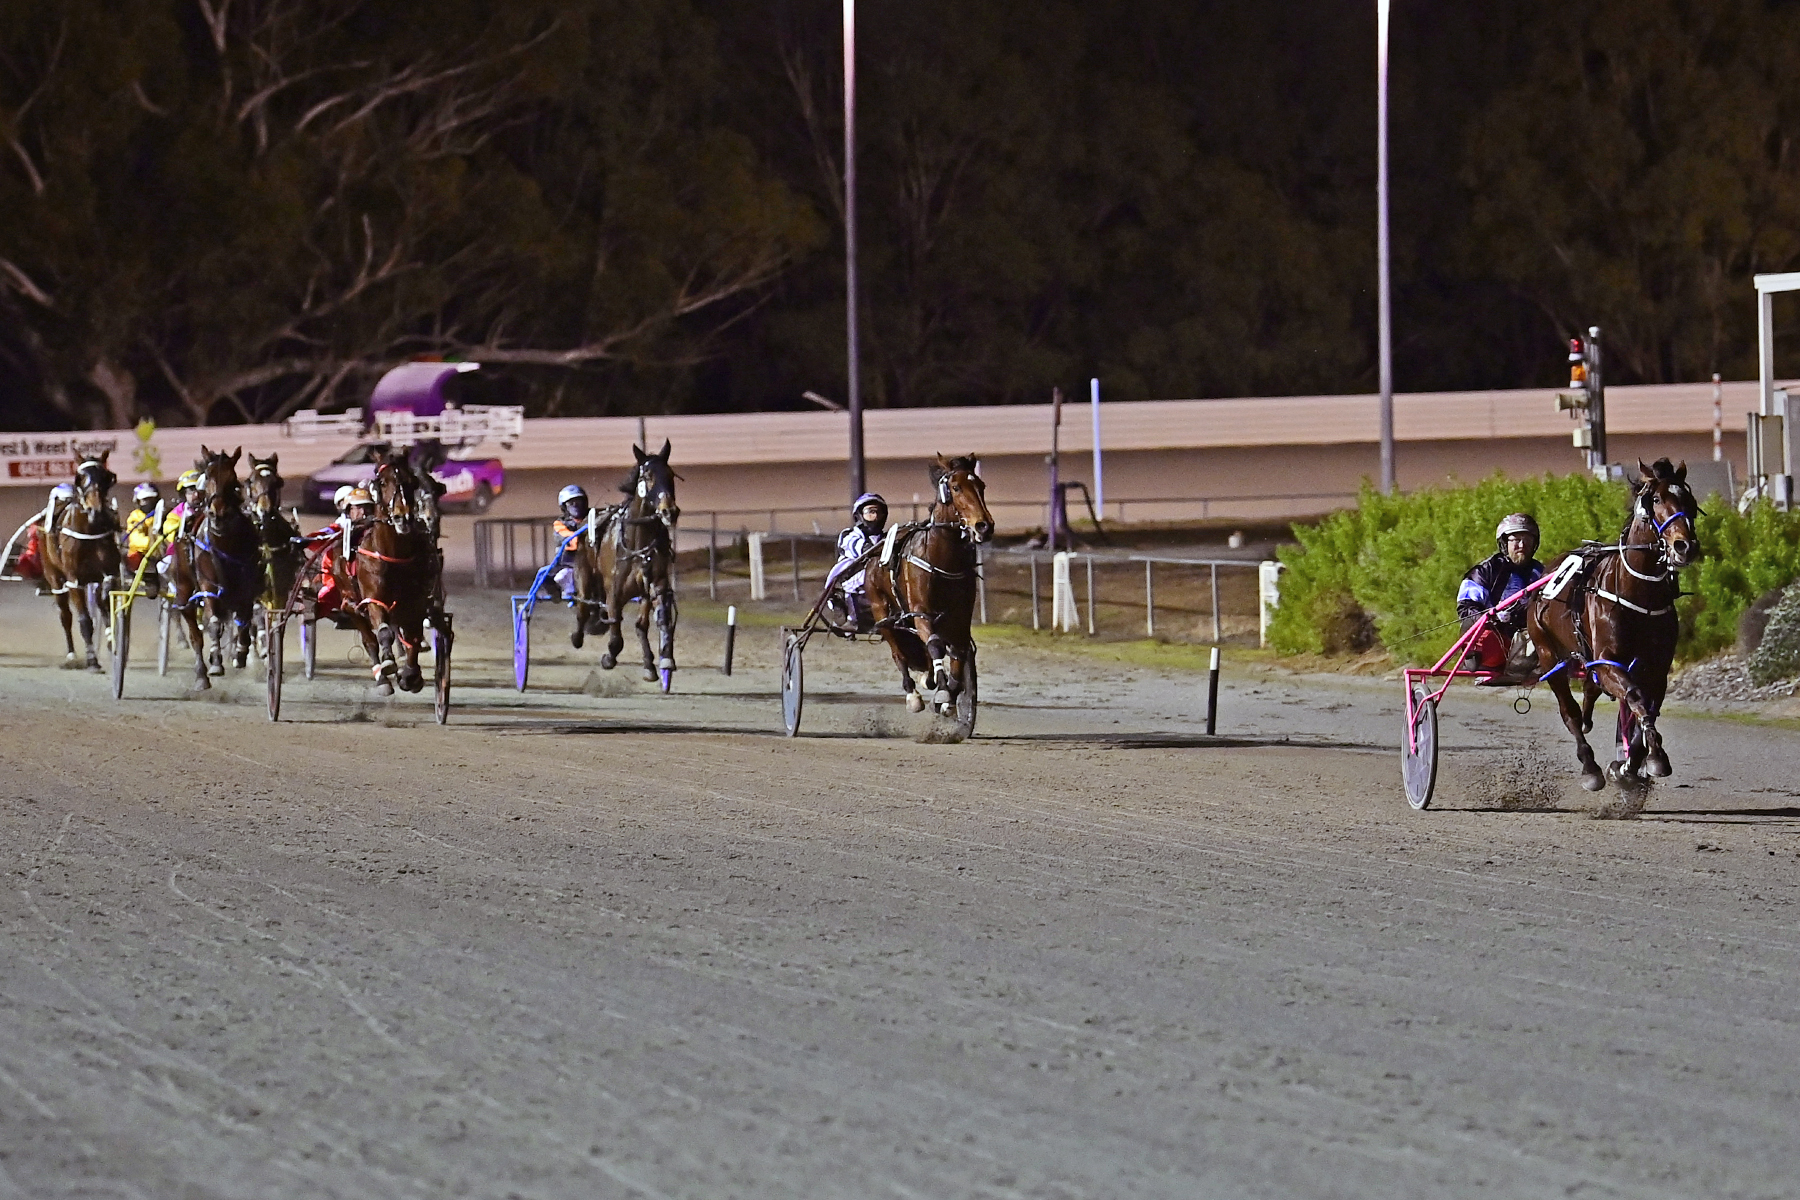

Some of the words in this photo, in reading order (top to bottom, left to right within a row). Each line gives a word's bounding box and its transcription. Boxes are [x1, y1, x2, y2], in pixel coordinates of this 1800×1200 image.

[34, 441, 66, 455] Weed
[70, 439, 117, 453] Control
[1552, 561, 1575, 591] 4
